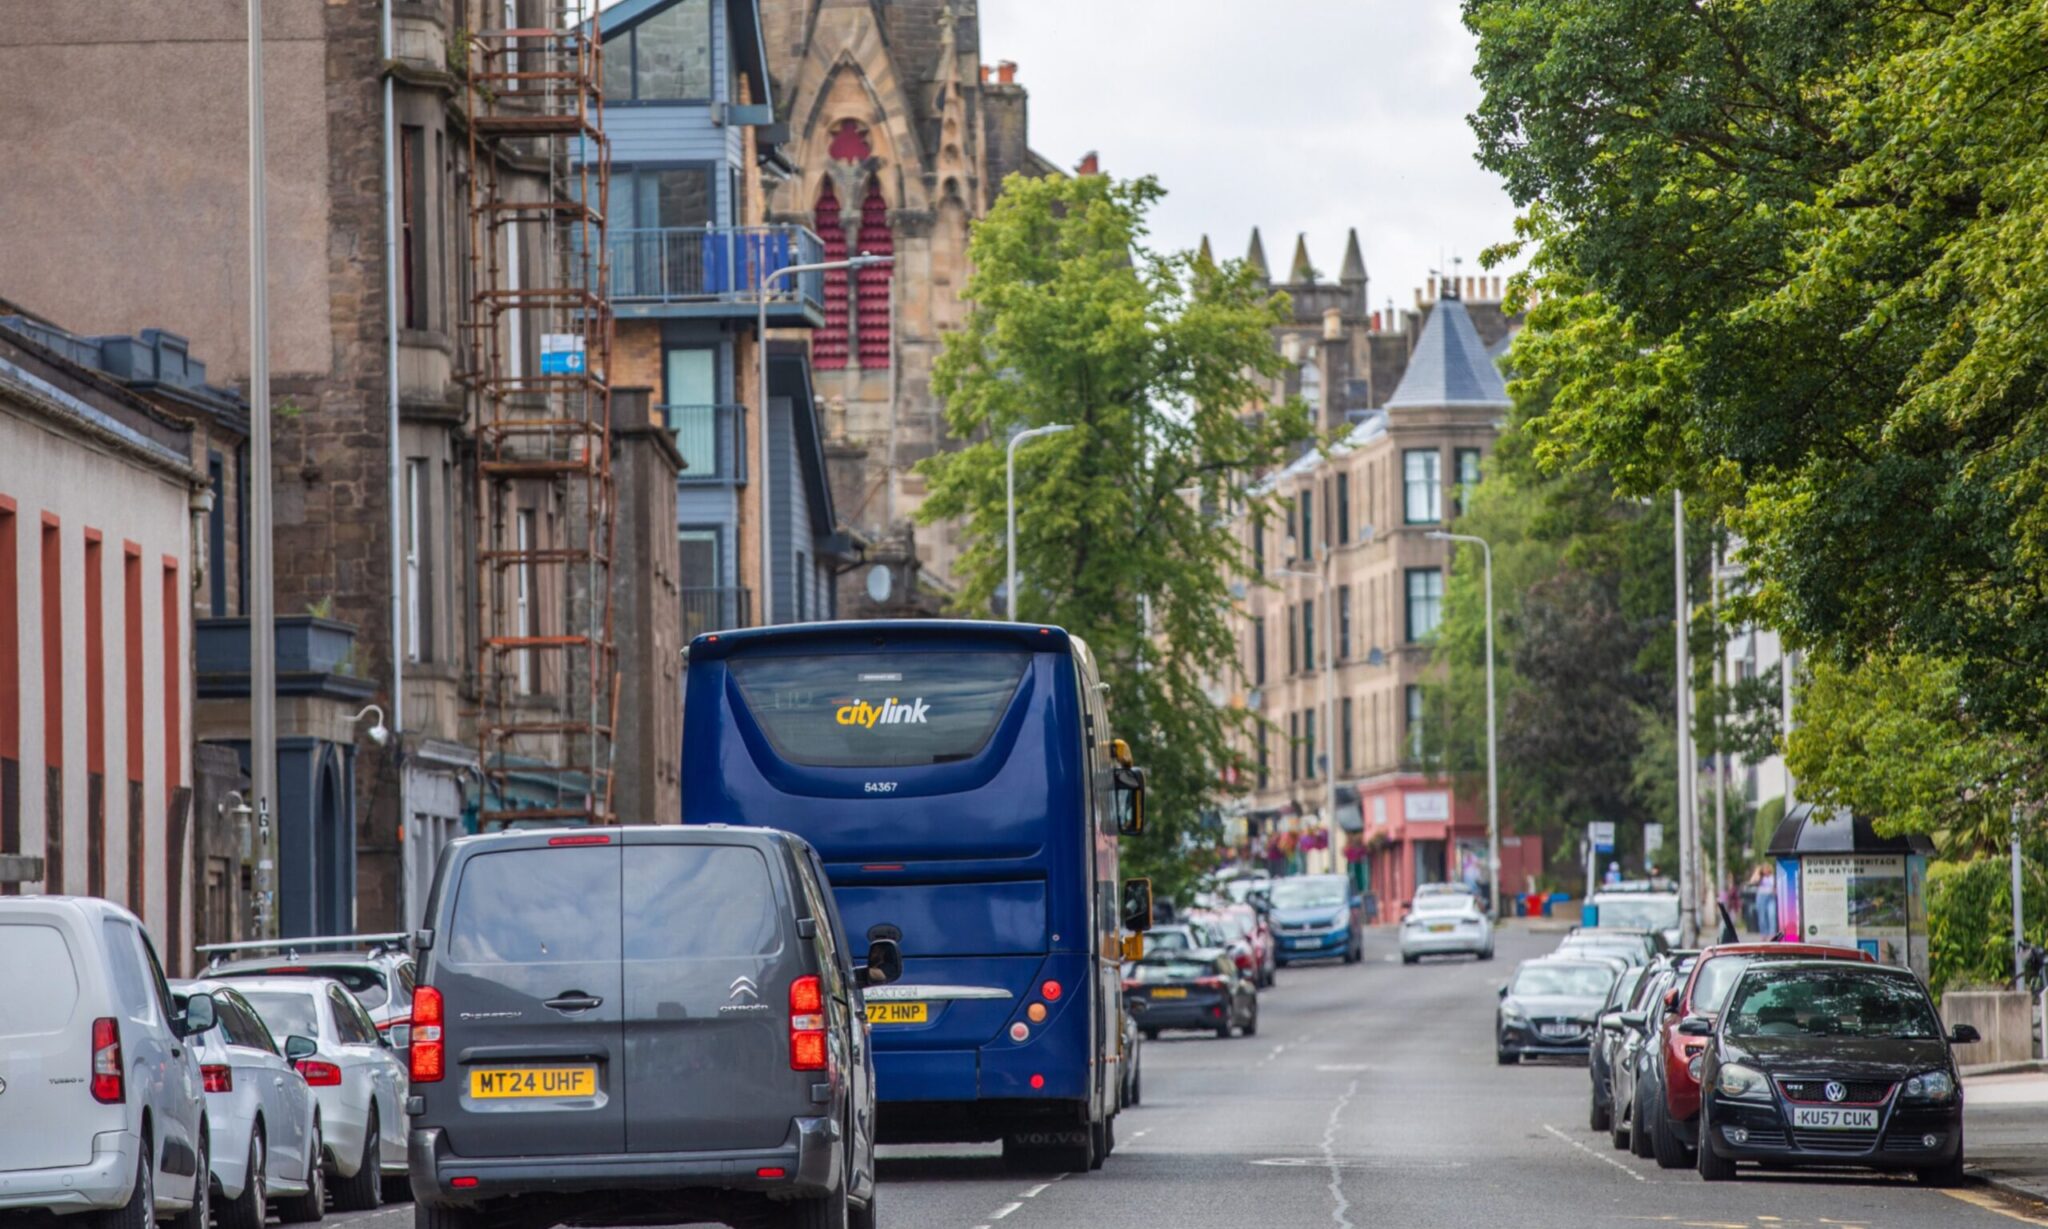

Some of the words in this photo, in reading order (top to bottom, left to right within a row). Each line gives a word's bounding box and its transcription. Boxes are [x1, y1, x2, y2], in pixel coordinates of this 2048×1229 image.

[836, 698, 930, 728] citylink
[864, 782, 898, 792] 54367
[866, 1006, 887, 1020] 72
[891, 1005, 920, 1019] HNP
[480, 1072, 536, 1092] MT24
[543, 1071, 585, 1091] UHF
[1801, 1110, 1839, 1125] KU57
[1843, 1111, 1872, 1126] CUK
[1016, 1132, 1087, 1145] VOLVO
